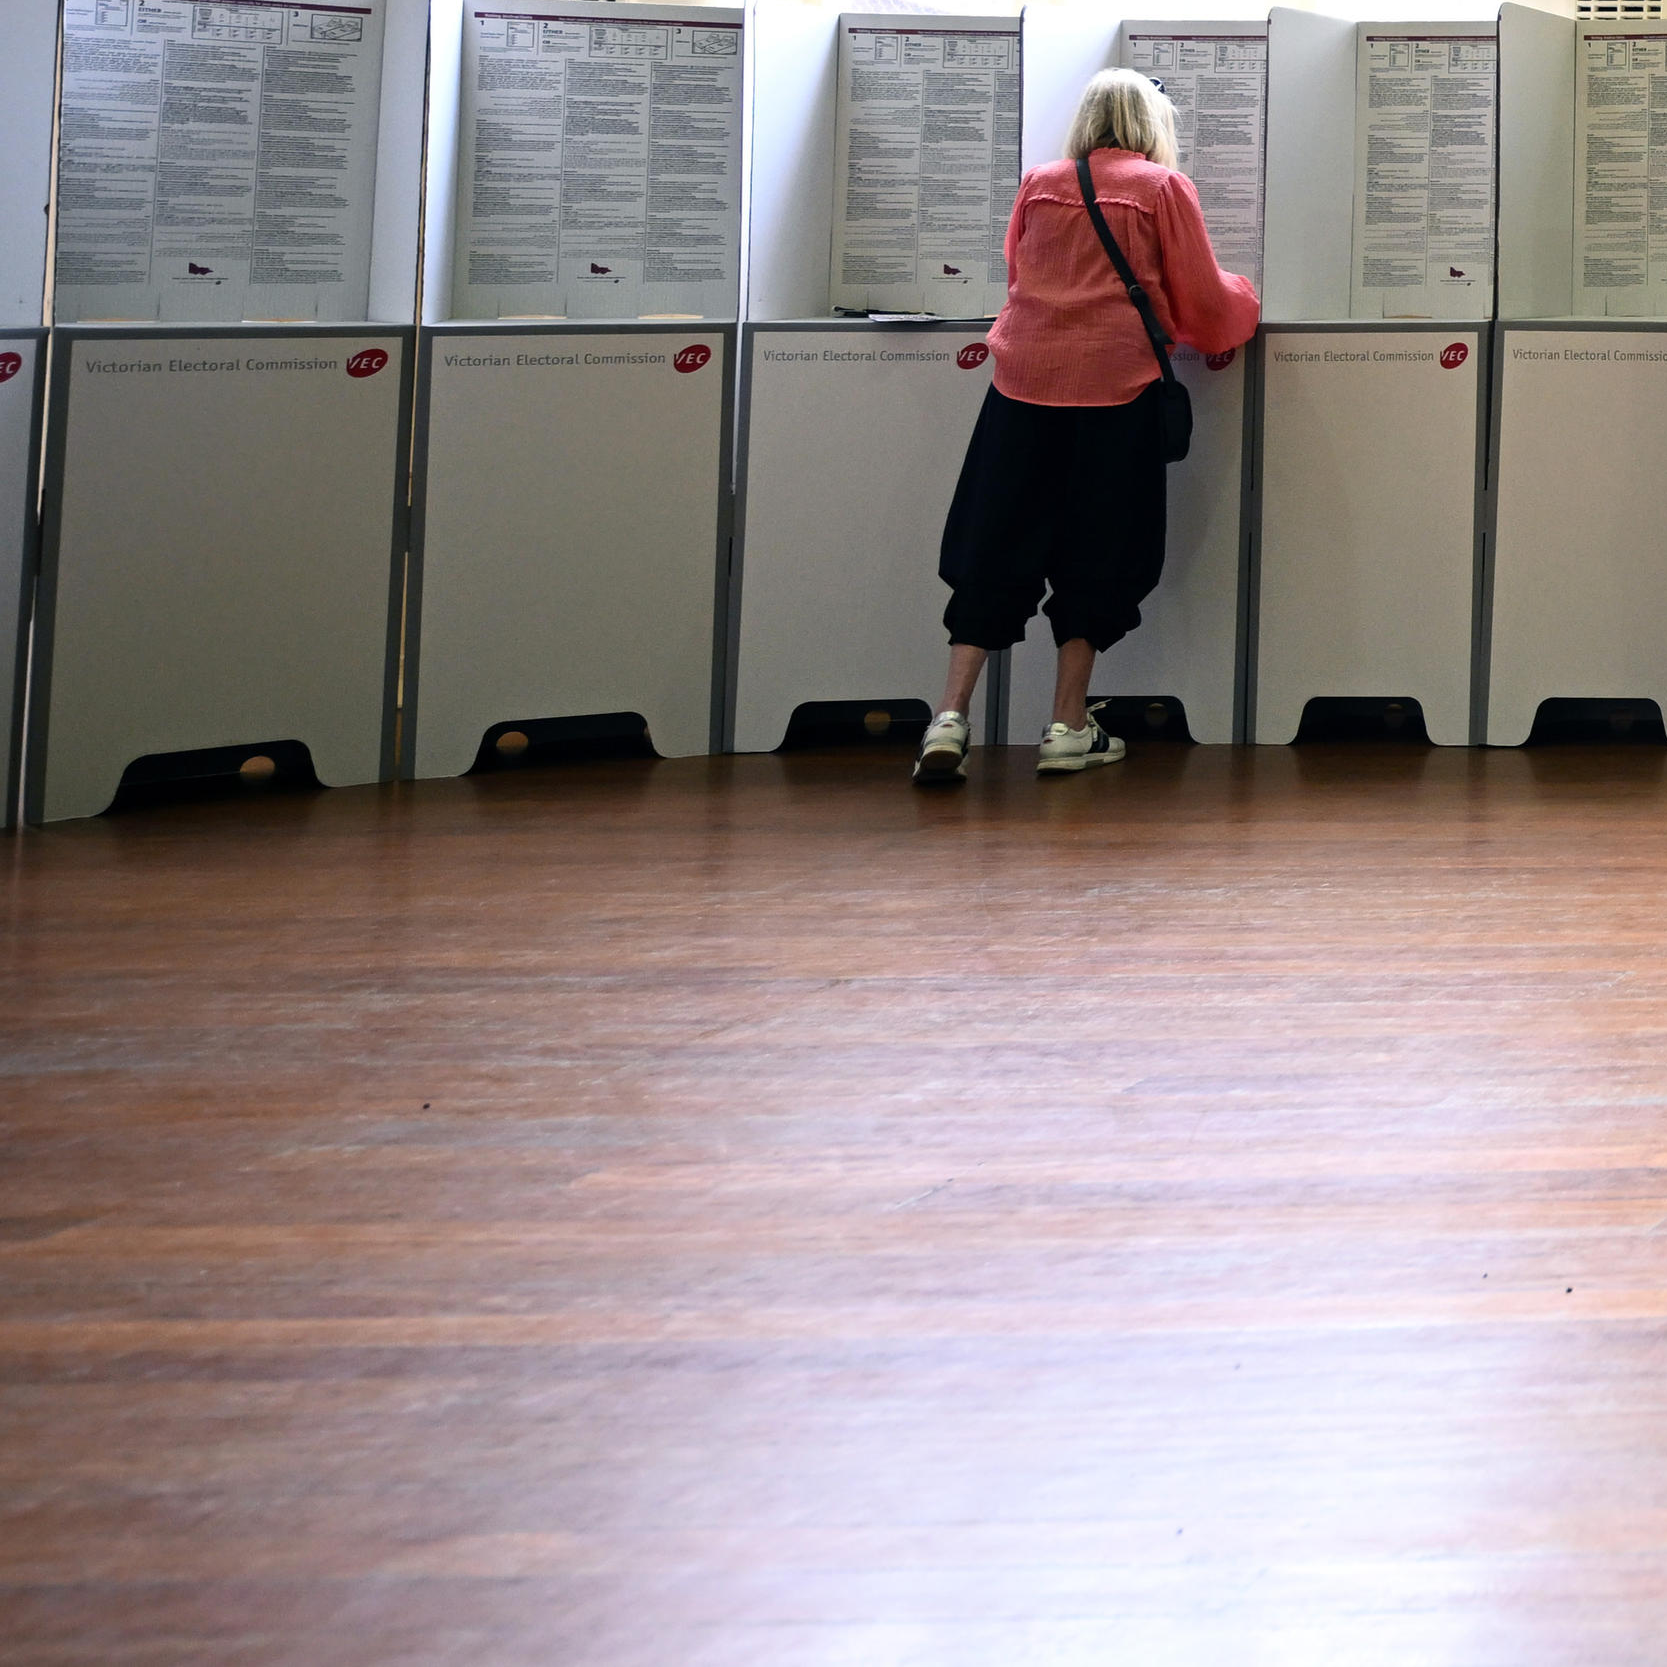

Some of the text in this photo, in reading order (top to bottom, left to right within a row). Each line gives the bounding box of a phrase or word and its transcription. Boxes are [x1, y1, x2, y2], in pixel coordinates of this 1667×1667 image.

[445, 355, 510, 366] Victorian
[517, 354, 578, 365] Electoral
[584, 353, 665, 364] Commission
[764, 350, 818, 361] Victorian
[823, 351, 876, 362] Electoral
[880, 350, 949, 361] Commission
[1273, 349, 1320, 363] Victorian
[1324, 351, 1369, 363] Electoral
[1373, 350, 1433, 361] Commission
[1513, 349, 1560, 360] Victorian
[1564, 350, 1610, 360] Electoral
[86, 360, 162, 374] Victorian
[169, 359, 240, 372] Electoral
[246, 358, 337, 371] Commission
